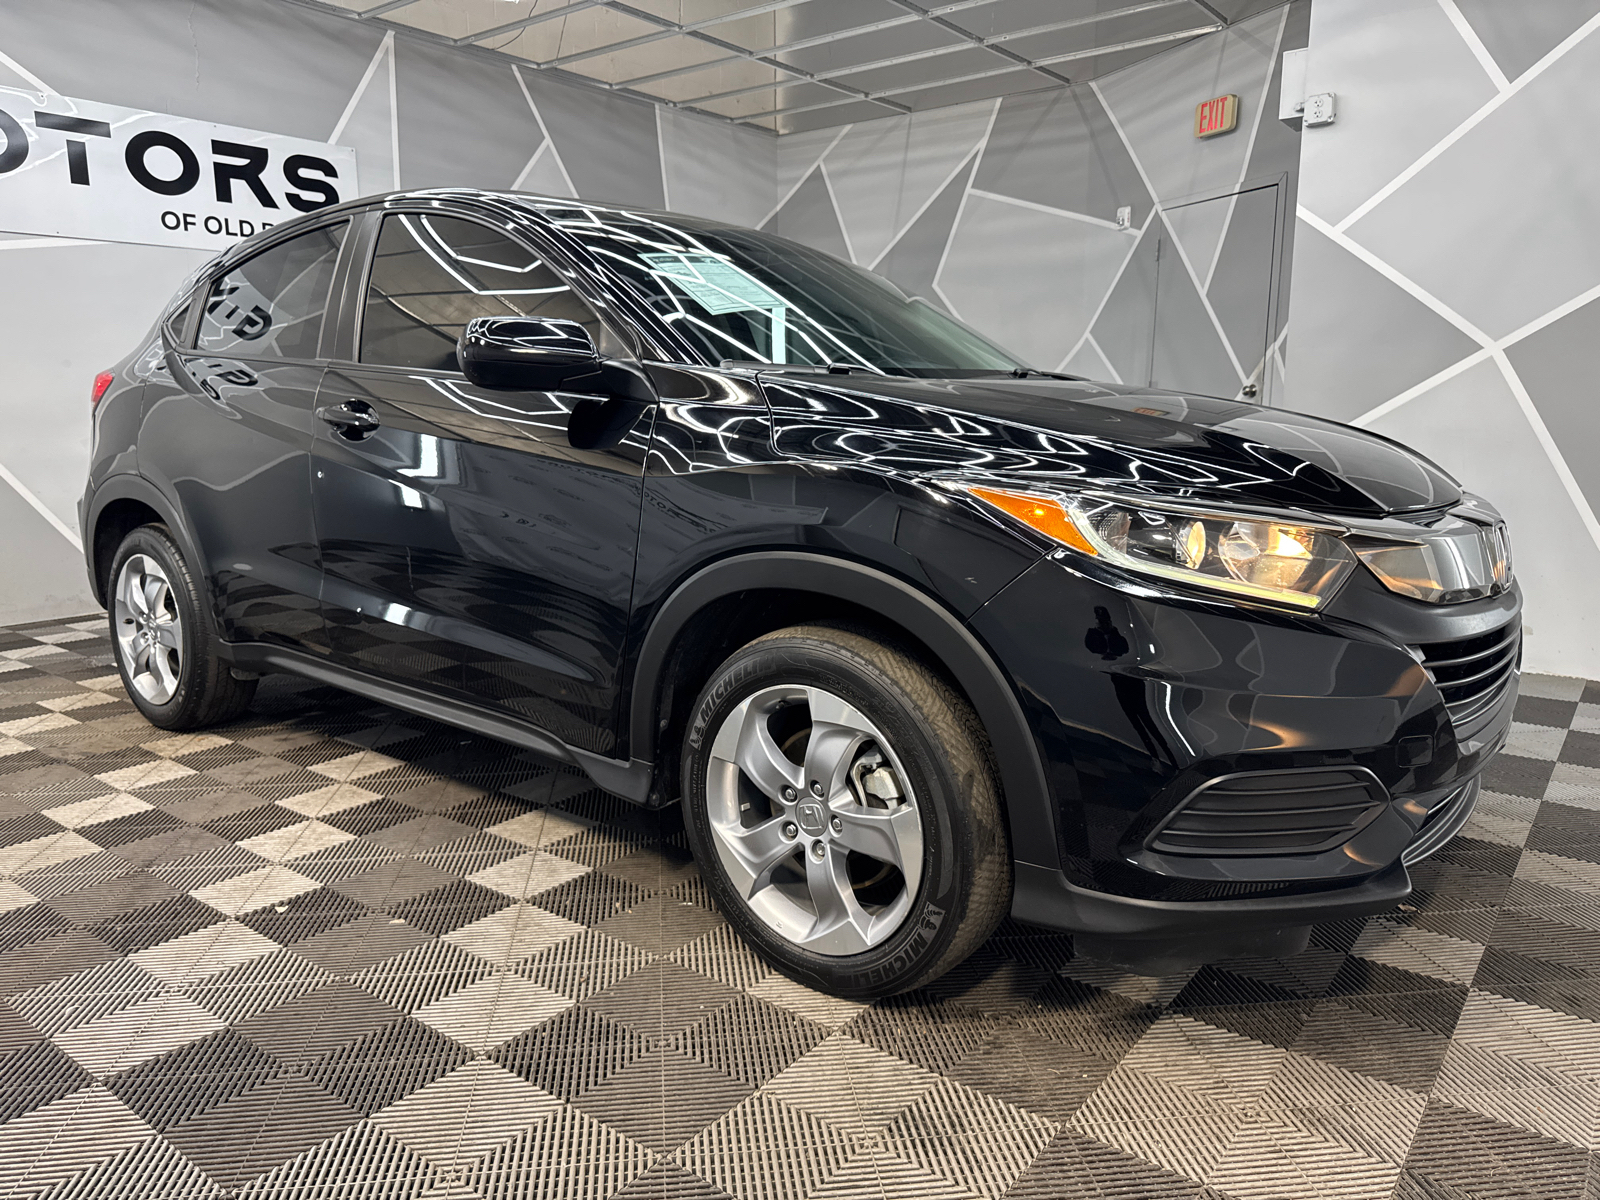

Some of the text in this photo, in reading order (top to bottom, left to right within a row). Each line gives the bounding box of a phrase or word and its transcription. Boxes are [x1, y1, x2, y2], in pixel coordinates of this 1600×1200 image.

[1199, 96, 1228, 134] EXIT
[160, 210, 197, 232] OF
[203, 215, 256, 238] OLD
[699, 652, 777, 723] MICHELIN
[838, 930, 930, 989] MICHELIN
